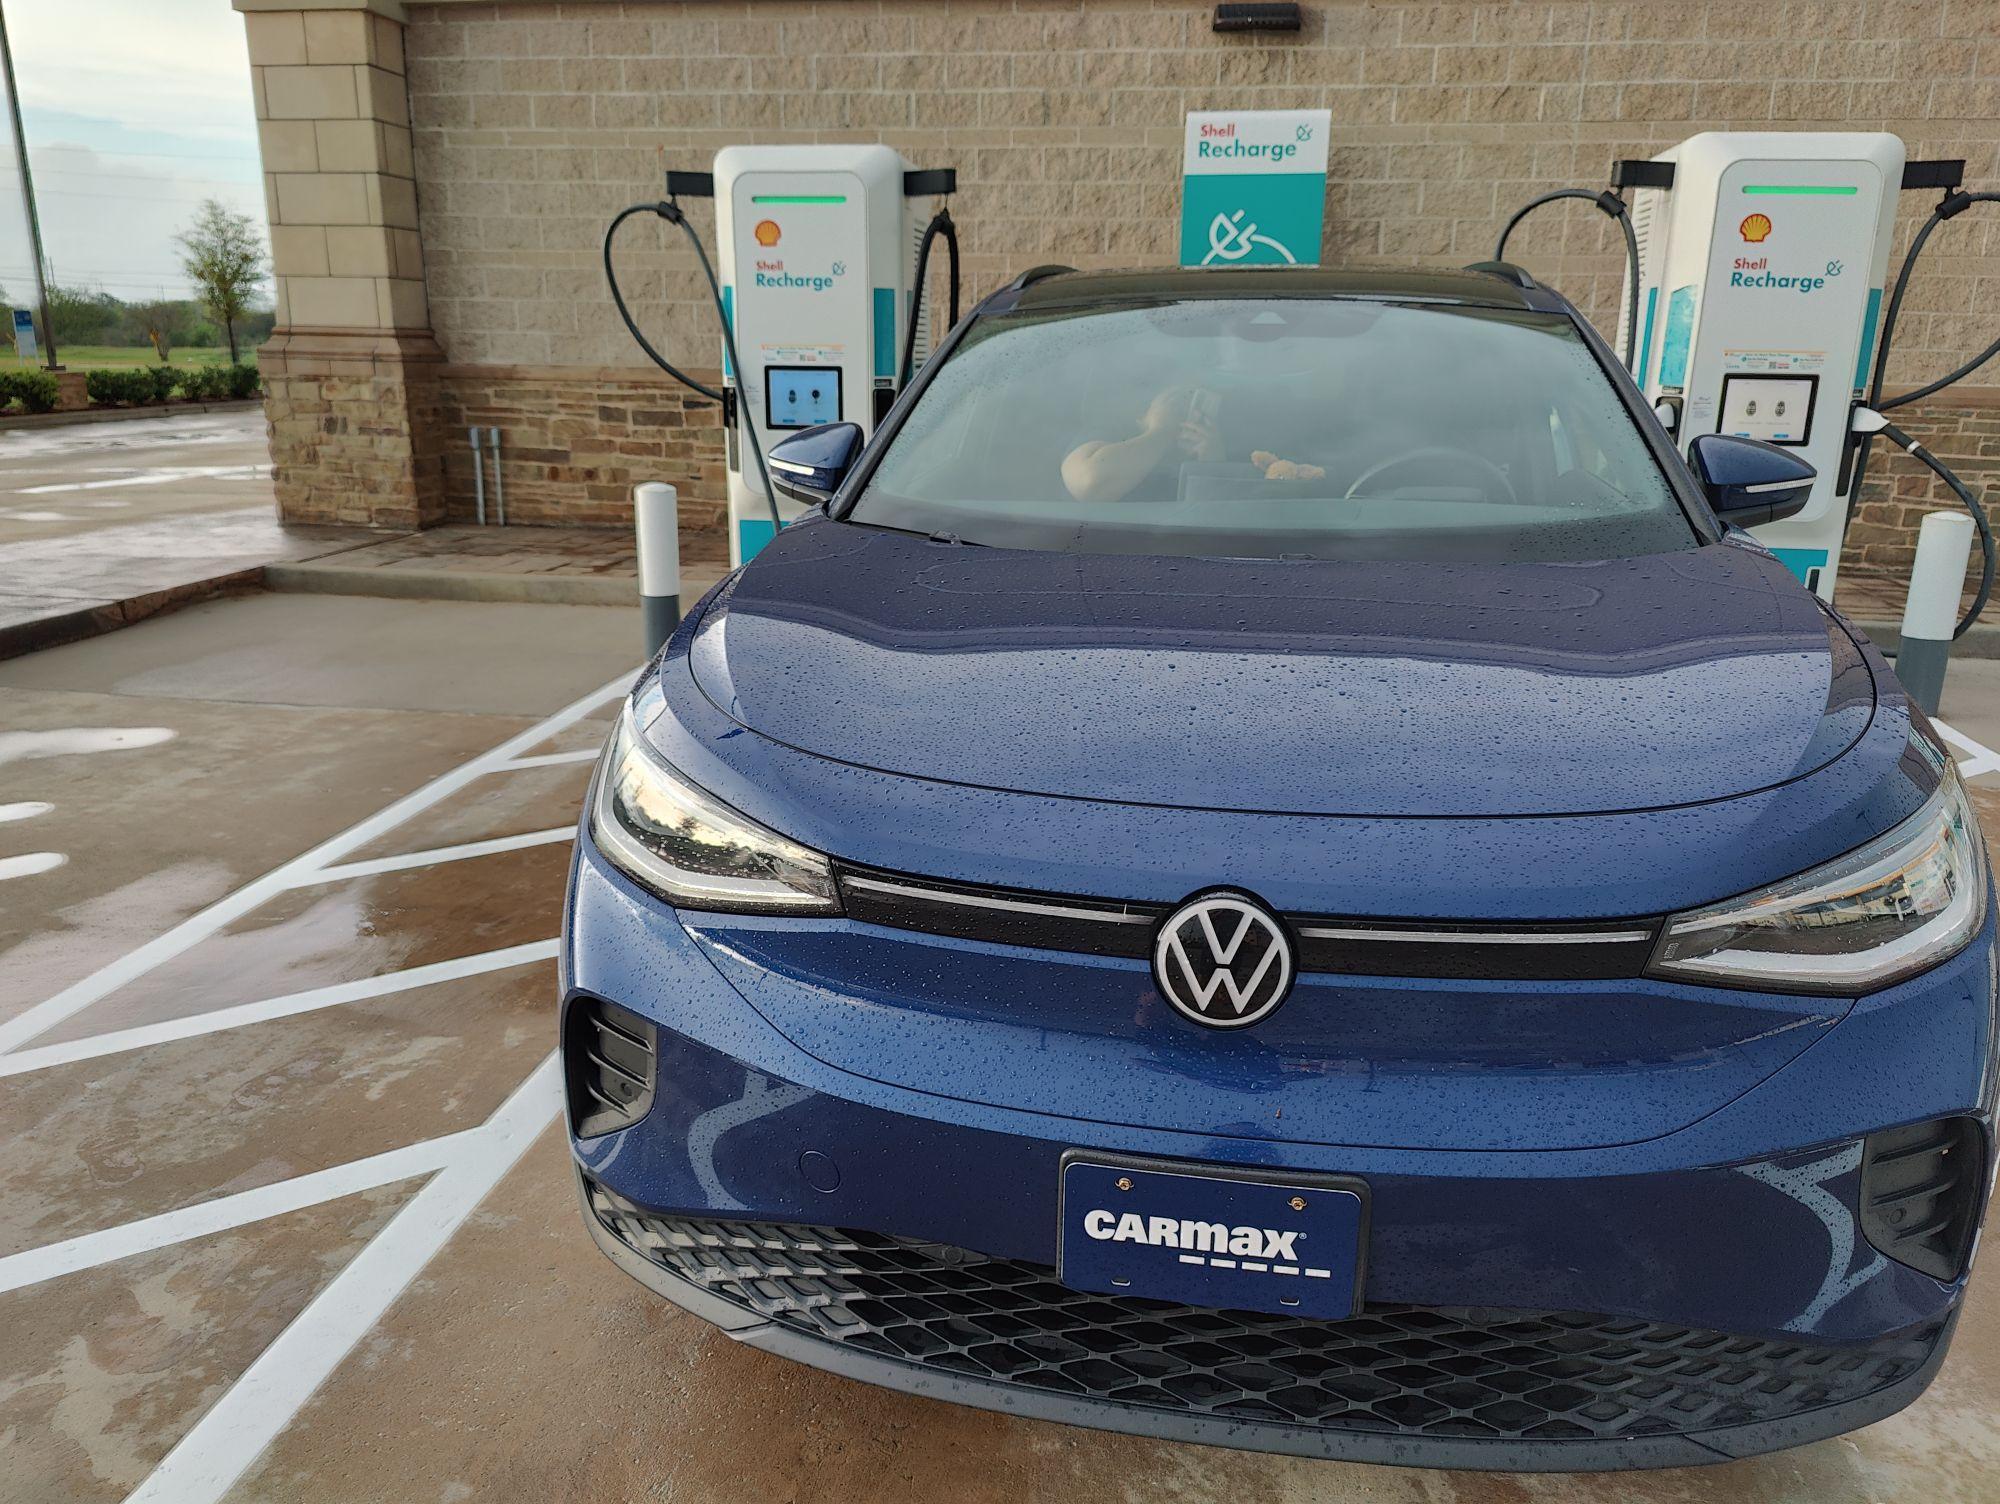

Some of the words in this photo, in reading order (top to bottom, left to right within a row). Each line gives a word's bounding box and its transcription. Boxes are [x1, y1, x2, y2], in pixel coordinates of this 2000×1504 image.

[1200, 123, 1236, 138] Shell
[1198, 139, 1297, 161] Recharge
[756, 260, 784, 271] Shell
[1734, 257, 1767, 270] Shell
[755, 272, 833, 291] Recharge
[1730, 271, 1825, 293] Recharge
[1159, 900, 1288, 1024] VW
